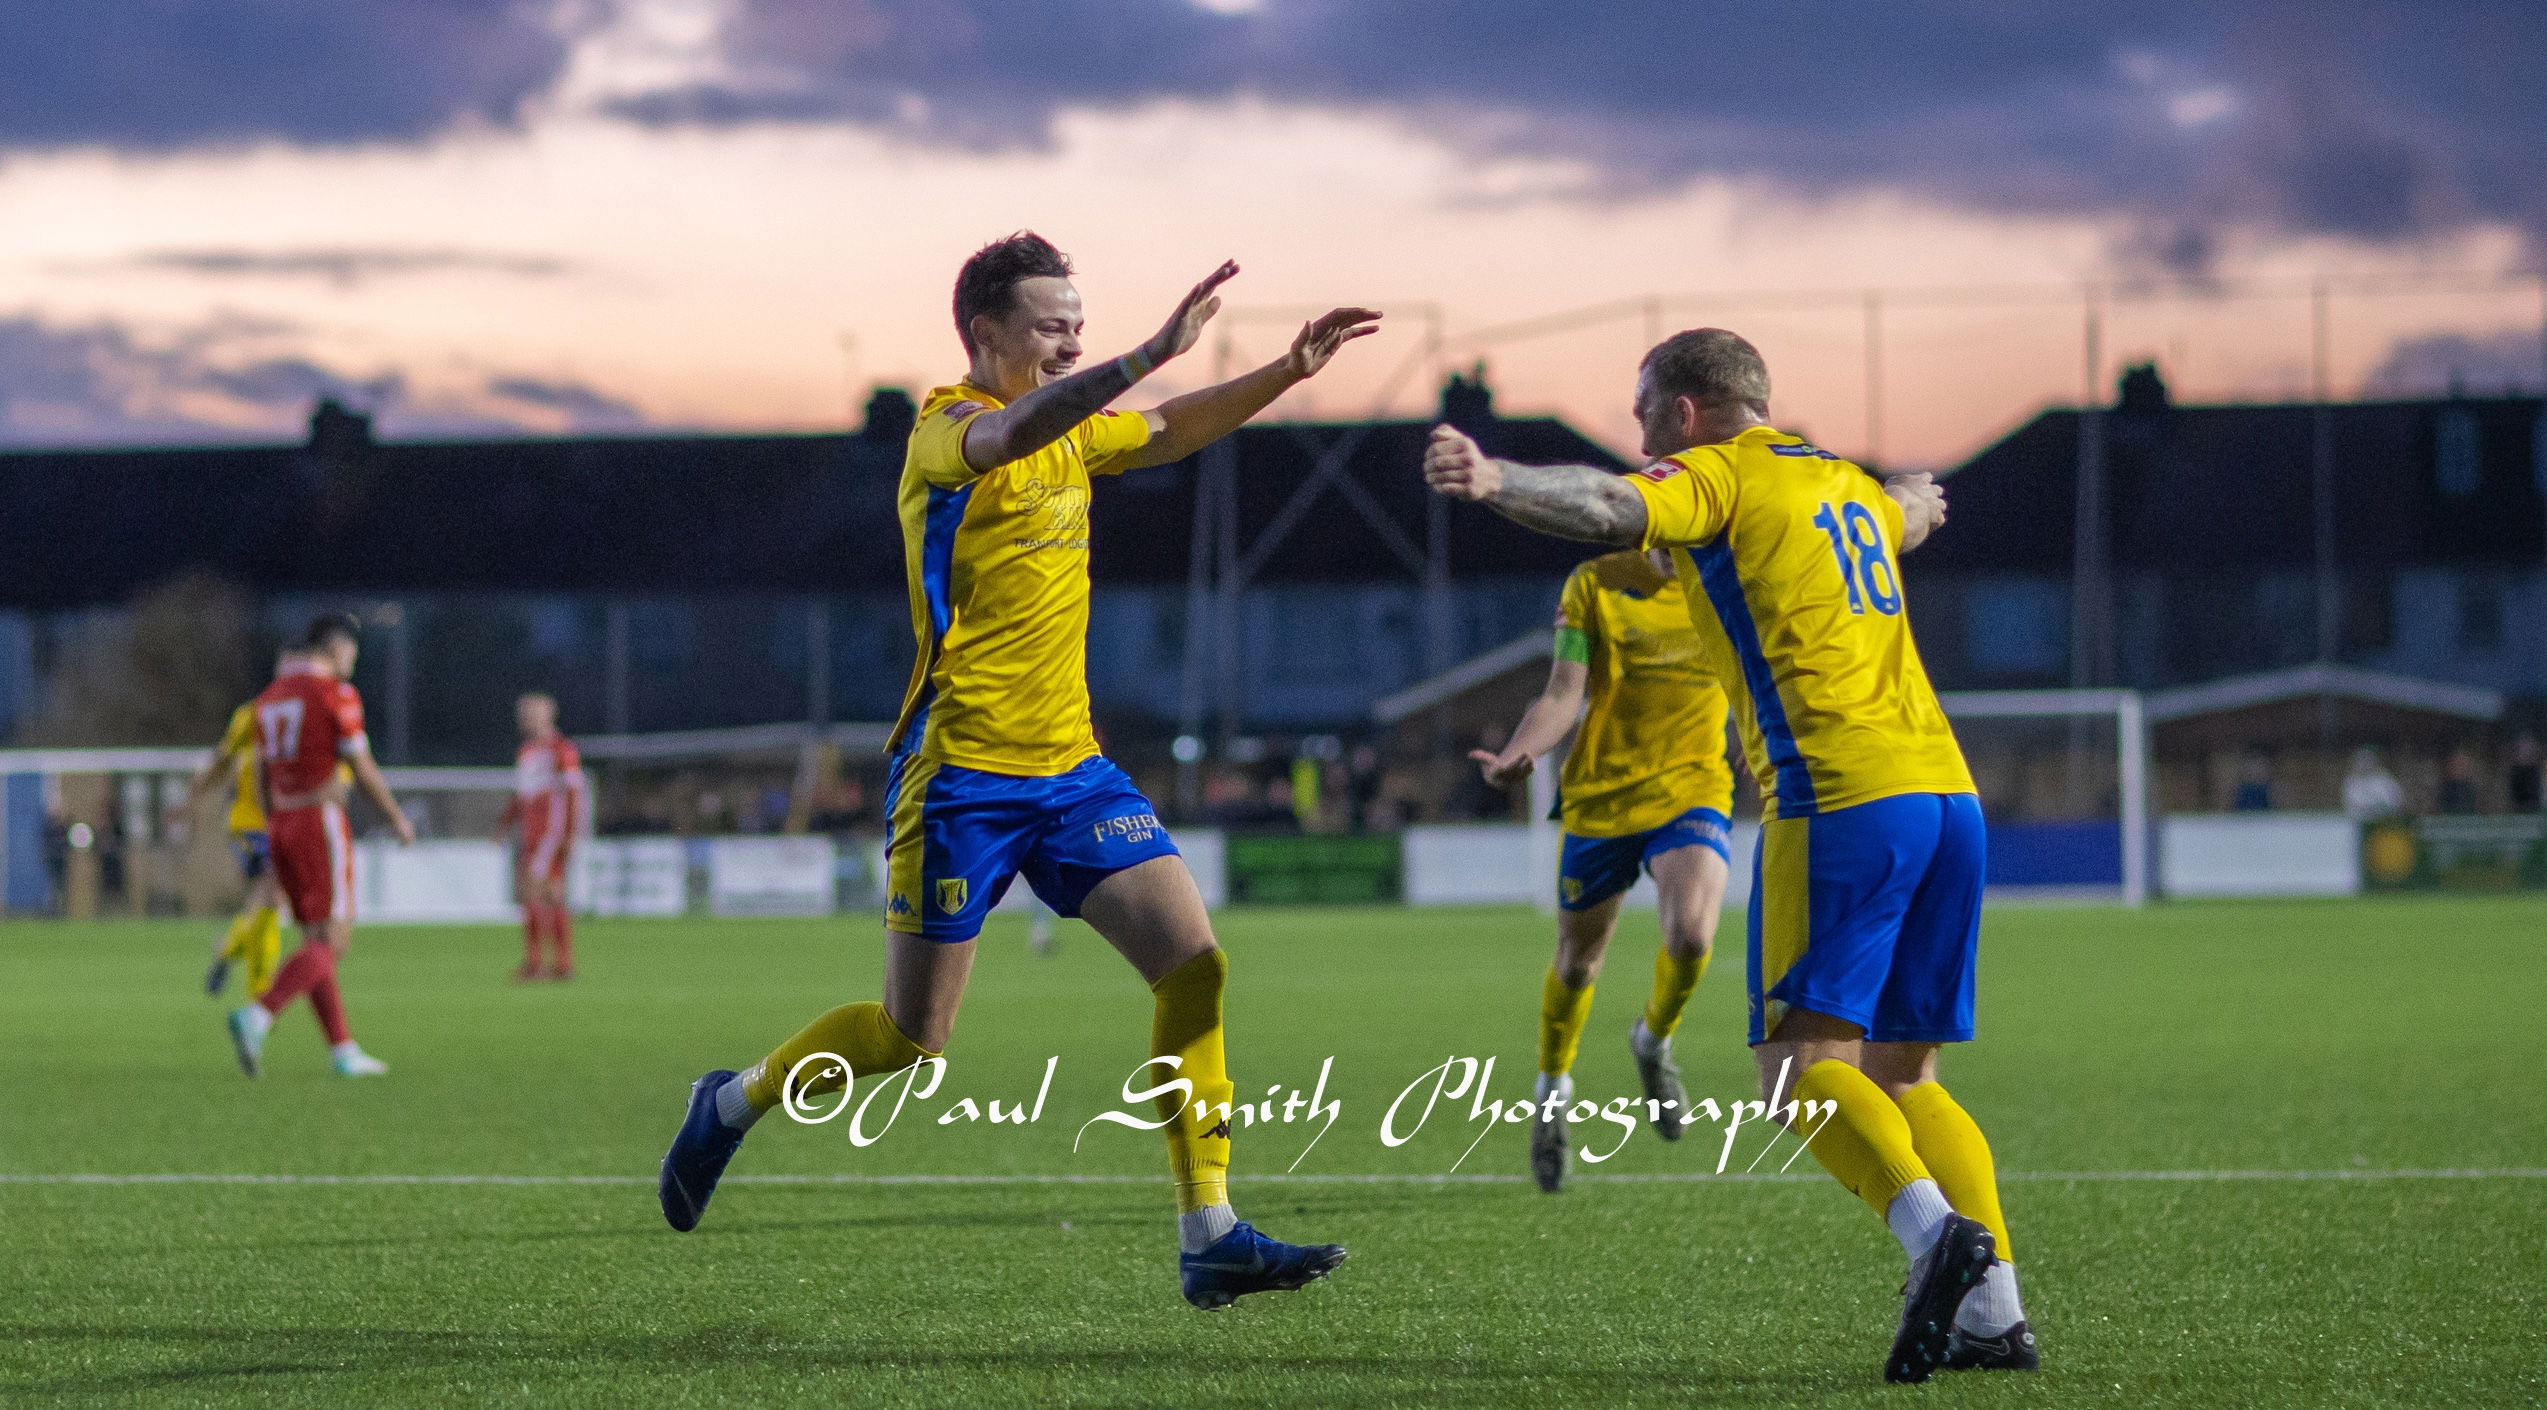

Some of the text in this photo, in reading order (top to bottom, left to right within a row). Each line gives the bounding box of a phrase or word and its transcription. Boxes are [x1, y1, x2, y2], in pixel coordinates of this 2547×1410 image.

[1812, 501, 1902, 616] 18
[259, 697, 305, 760] 17
[1093, 814, 1166, 843] FISHER
[1127, 830, 1153, 843] GIN
